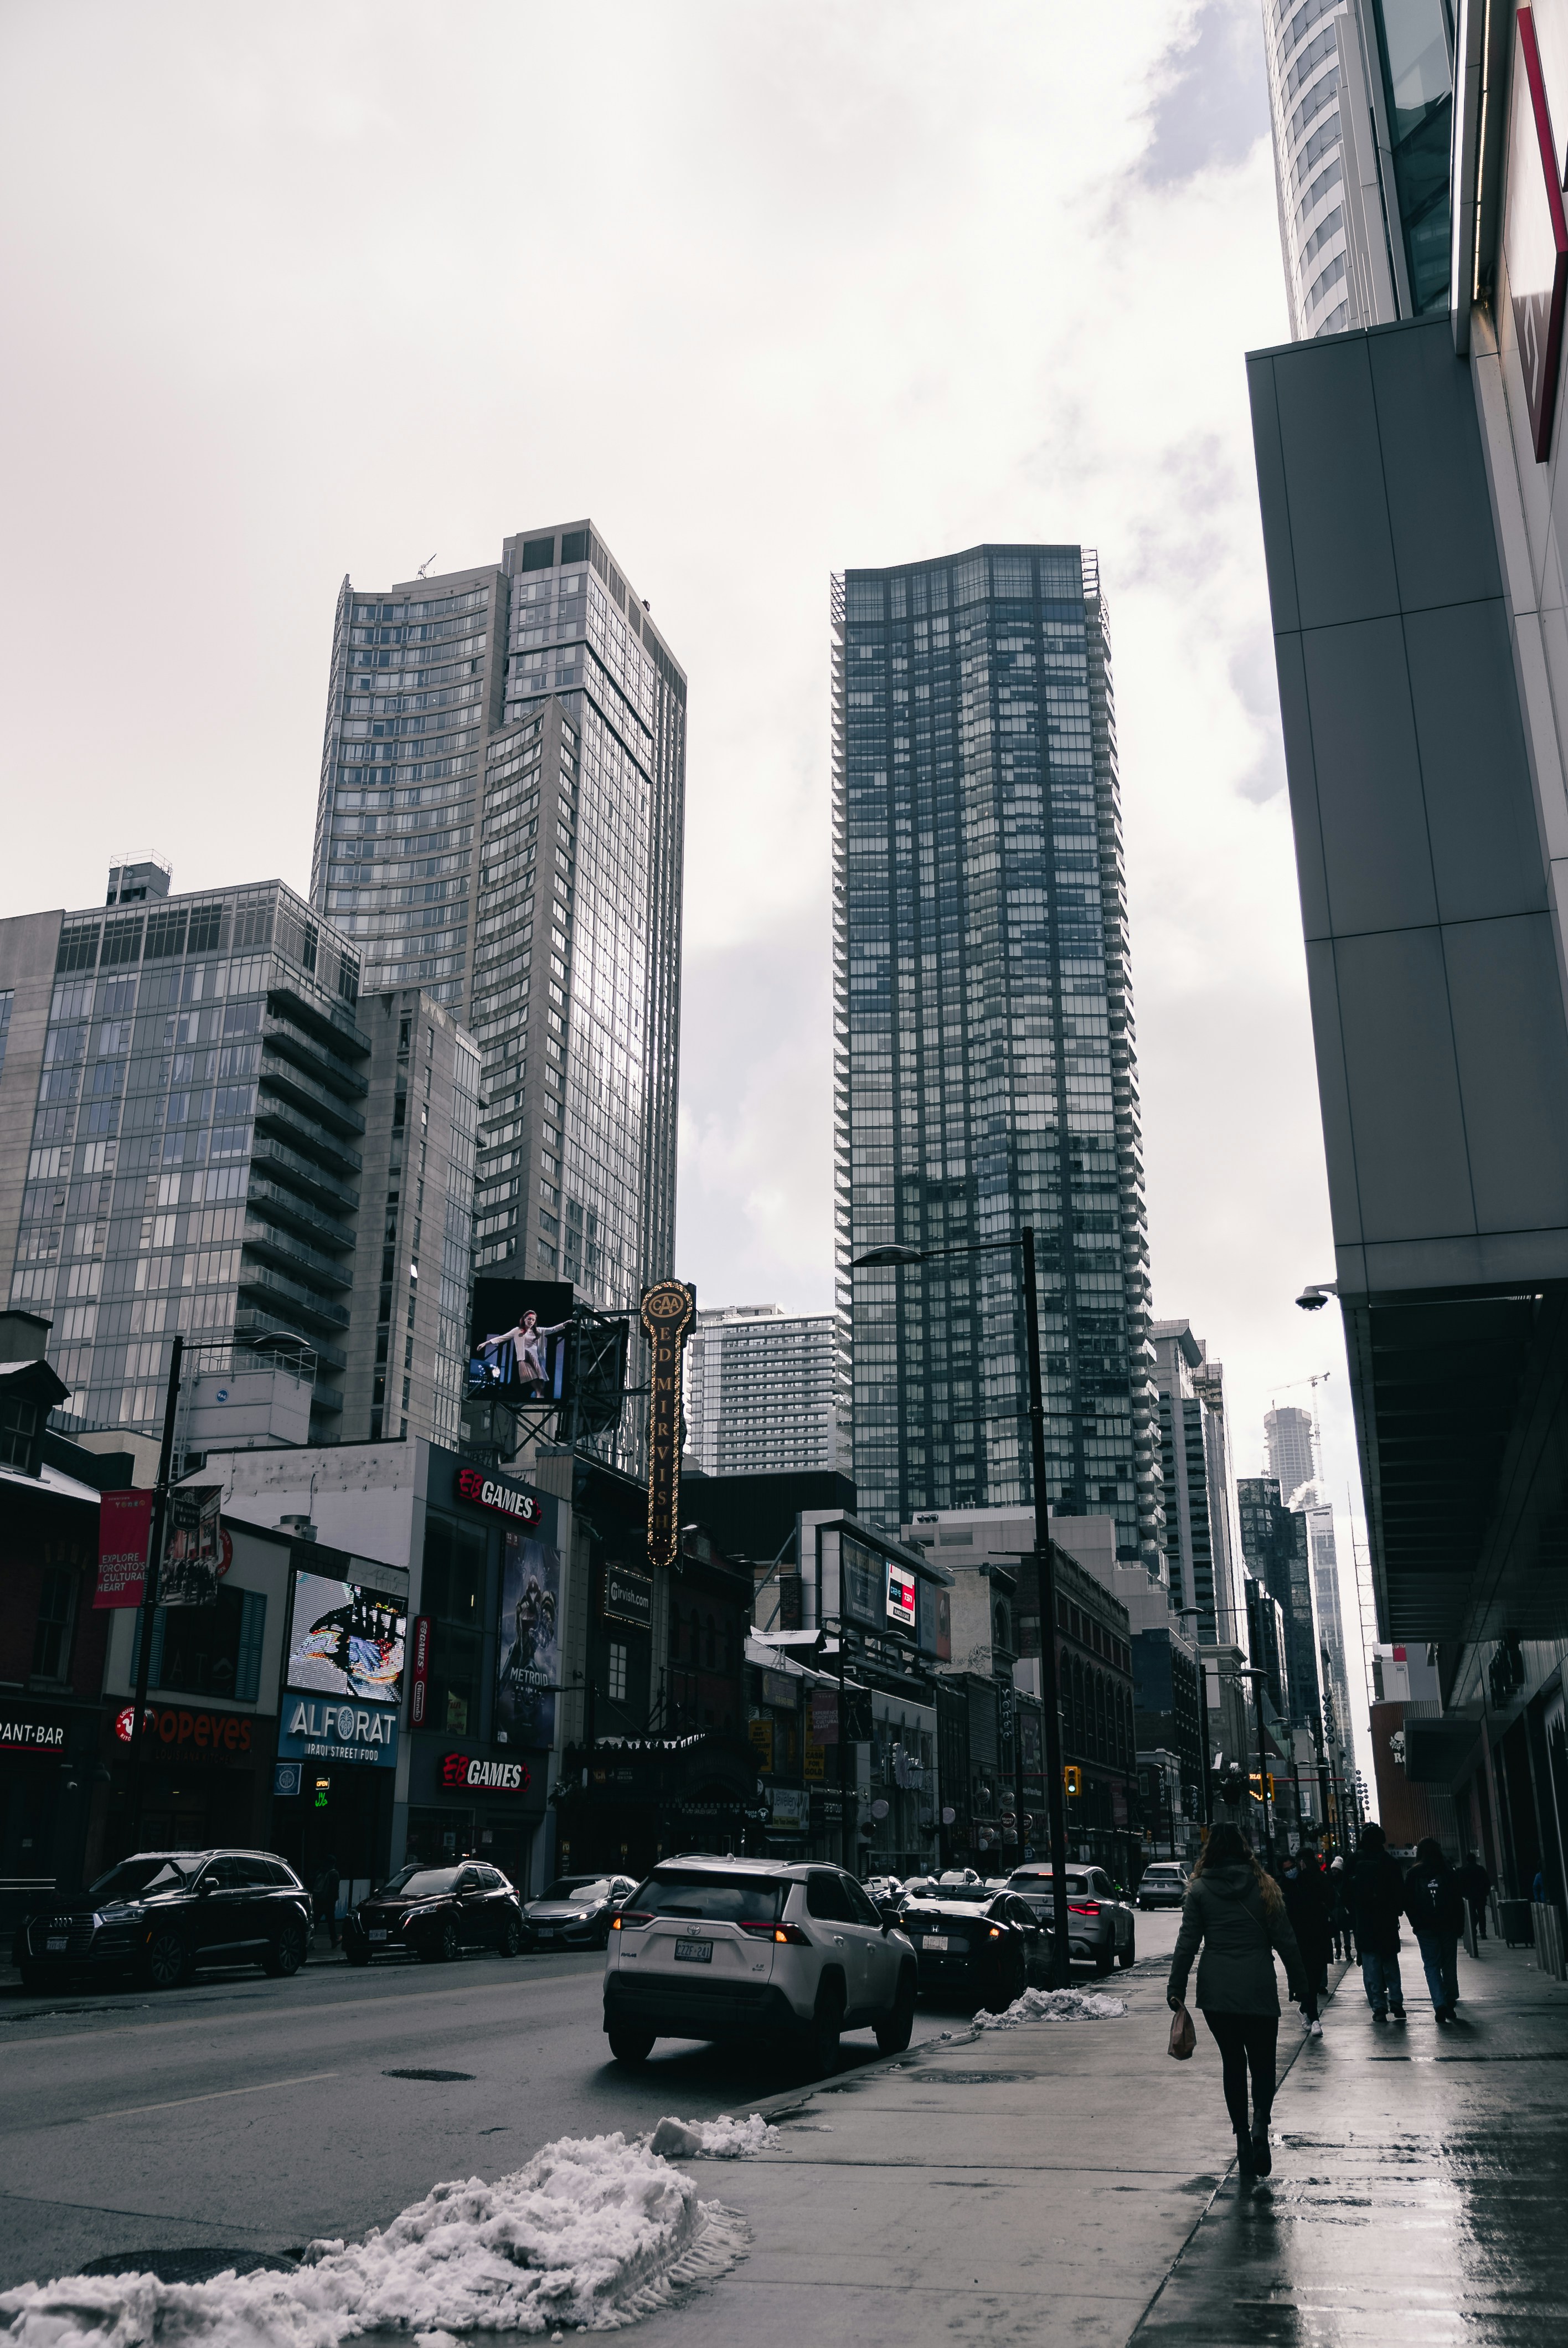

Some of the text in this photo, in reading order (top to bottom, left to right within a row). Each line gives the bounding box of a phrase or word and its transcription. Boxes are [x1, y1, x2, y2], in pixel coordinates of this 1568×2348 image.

[652, 1296, 679, 1315] CAA
[655, 1327, 672, 1529] ED MIRVISH
[459, 1469, 533, 1518] EB GAMES
[1265, 1485, 1280, 1493] MNP
[102, 1553, 140, 1563] EXPLORE
[99, 1562, 145, 1573] TORONTO'S
[104, 1572, 145, 1582] CULTURAL
[97, 1582, 126, 1592] HEART
[611, 1582, 649, 1608] mirvish.com
[904, 1592, 912, 1603] TSN
[510, 1667, 548, 1686] METROID
[288, 1702, 396, 1744] ALFORAT
[156, 1749, 235, 1764] LOUISIANA KITCHEN
[307, 1743, 378, 1761] IRAQI STREET FOOD
[443, 1753, 522, 1788] EB GAMES
[775, 1793, 797, 1810] Jewellery
[677, 1944, 710, 1958] CZZF 241
